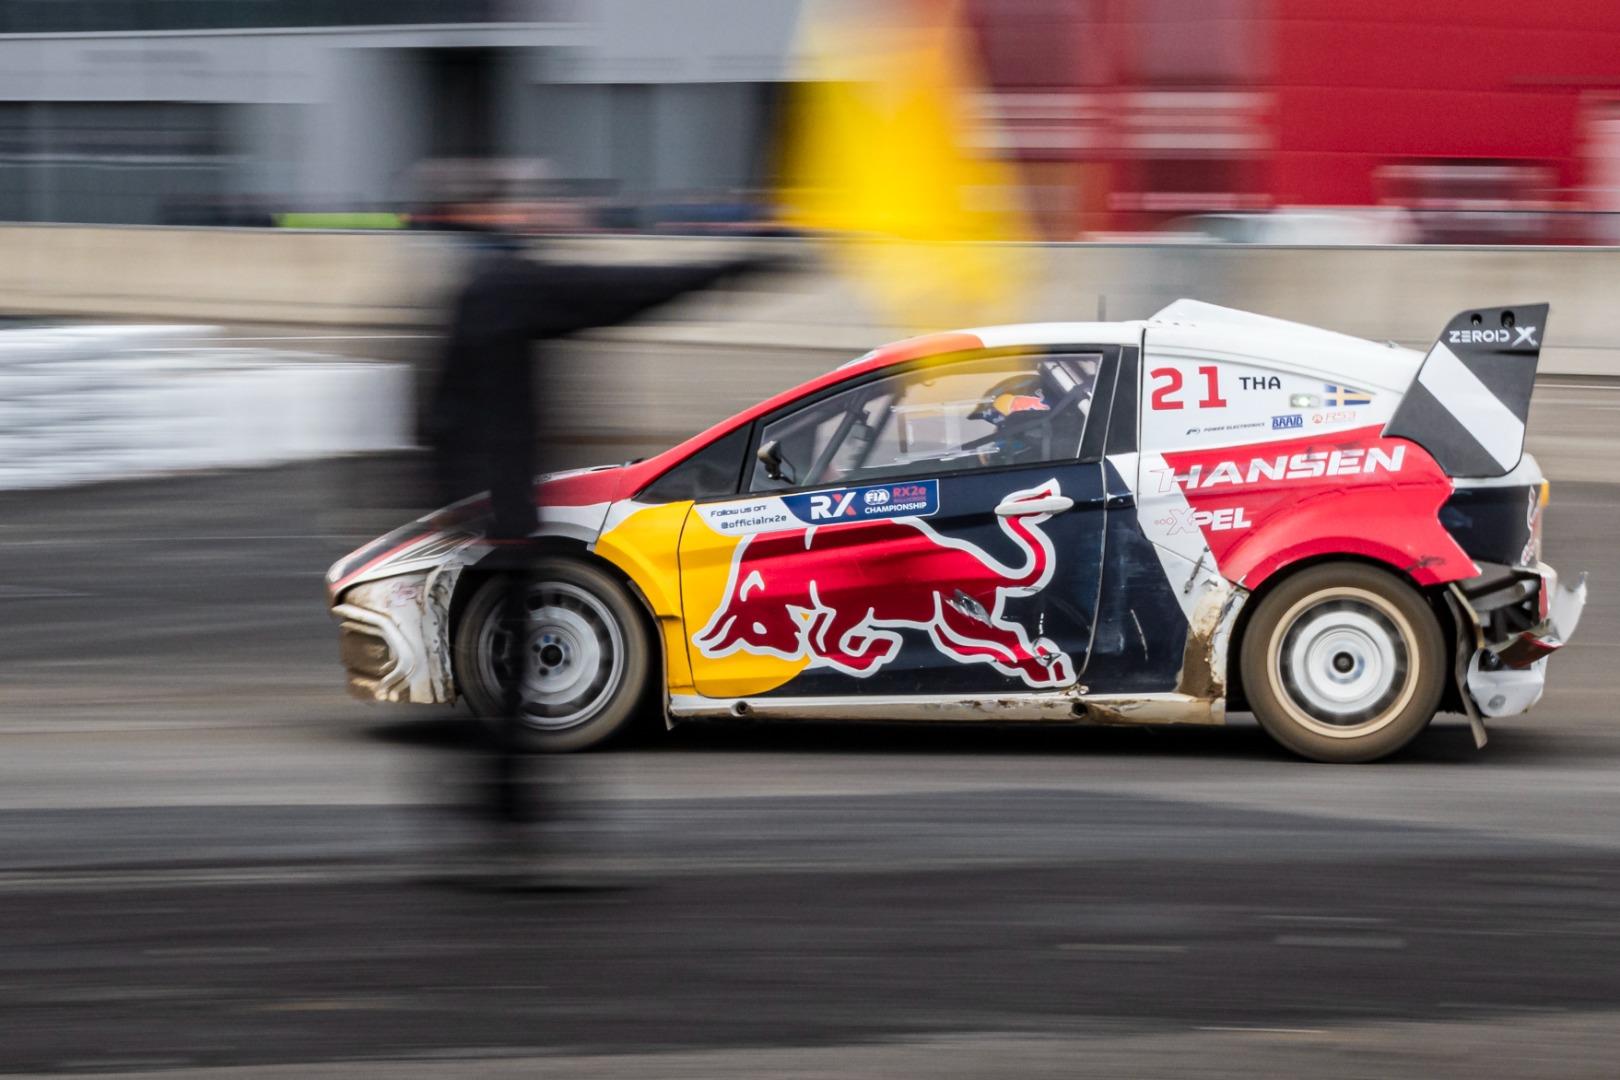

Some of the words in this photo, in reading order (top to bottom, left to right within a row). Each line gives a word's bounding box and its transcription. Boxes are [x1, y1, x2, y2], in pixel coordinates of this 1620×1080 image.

[1150, 366, 1227, 411] 21
[1238, 376, 1282, 391] THA
[1272, 415, 1303, 429] BRAID
[1150, 445, 1407, 493] HANSEN
[866, 491, 888, 503] FIA
[810, 491, 857, 520] RX
[864, 501, 927, 514] CHAMPIONSHIP
[721, 514, 788, 530] @officialrx2e
[1166, 507, 1252, 536] XPEL
